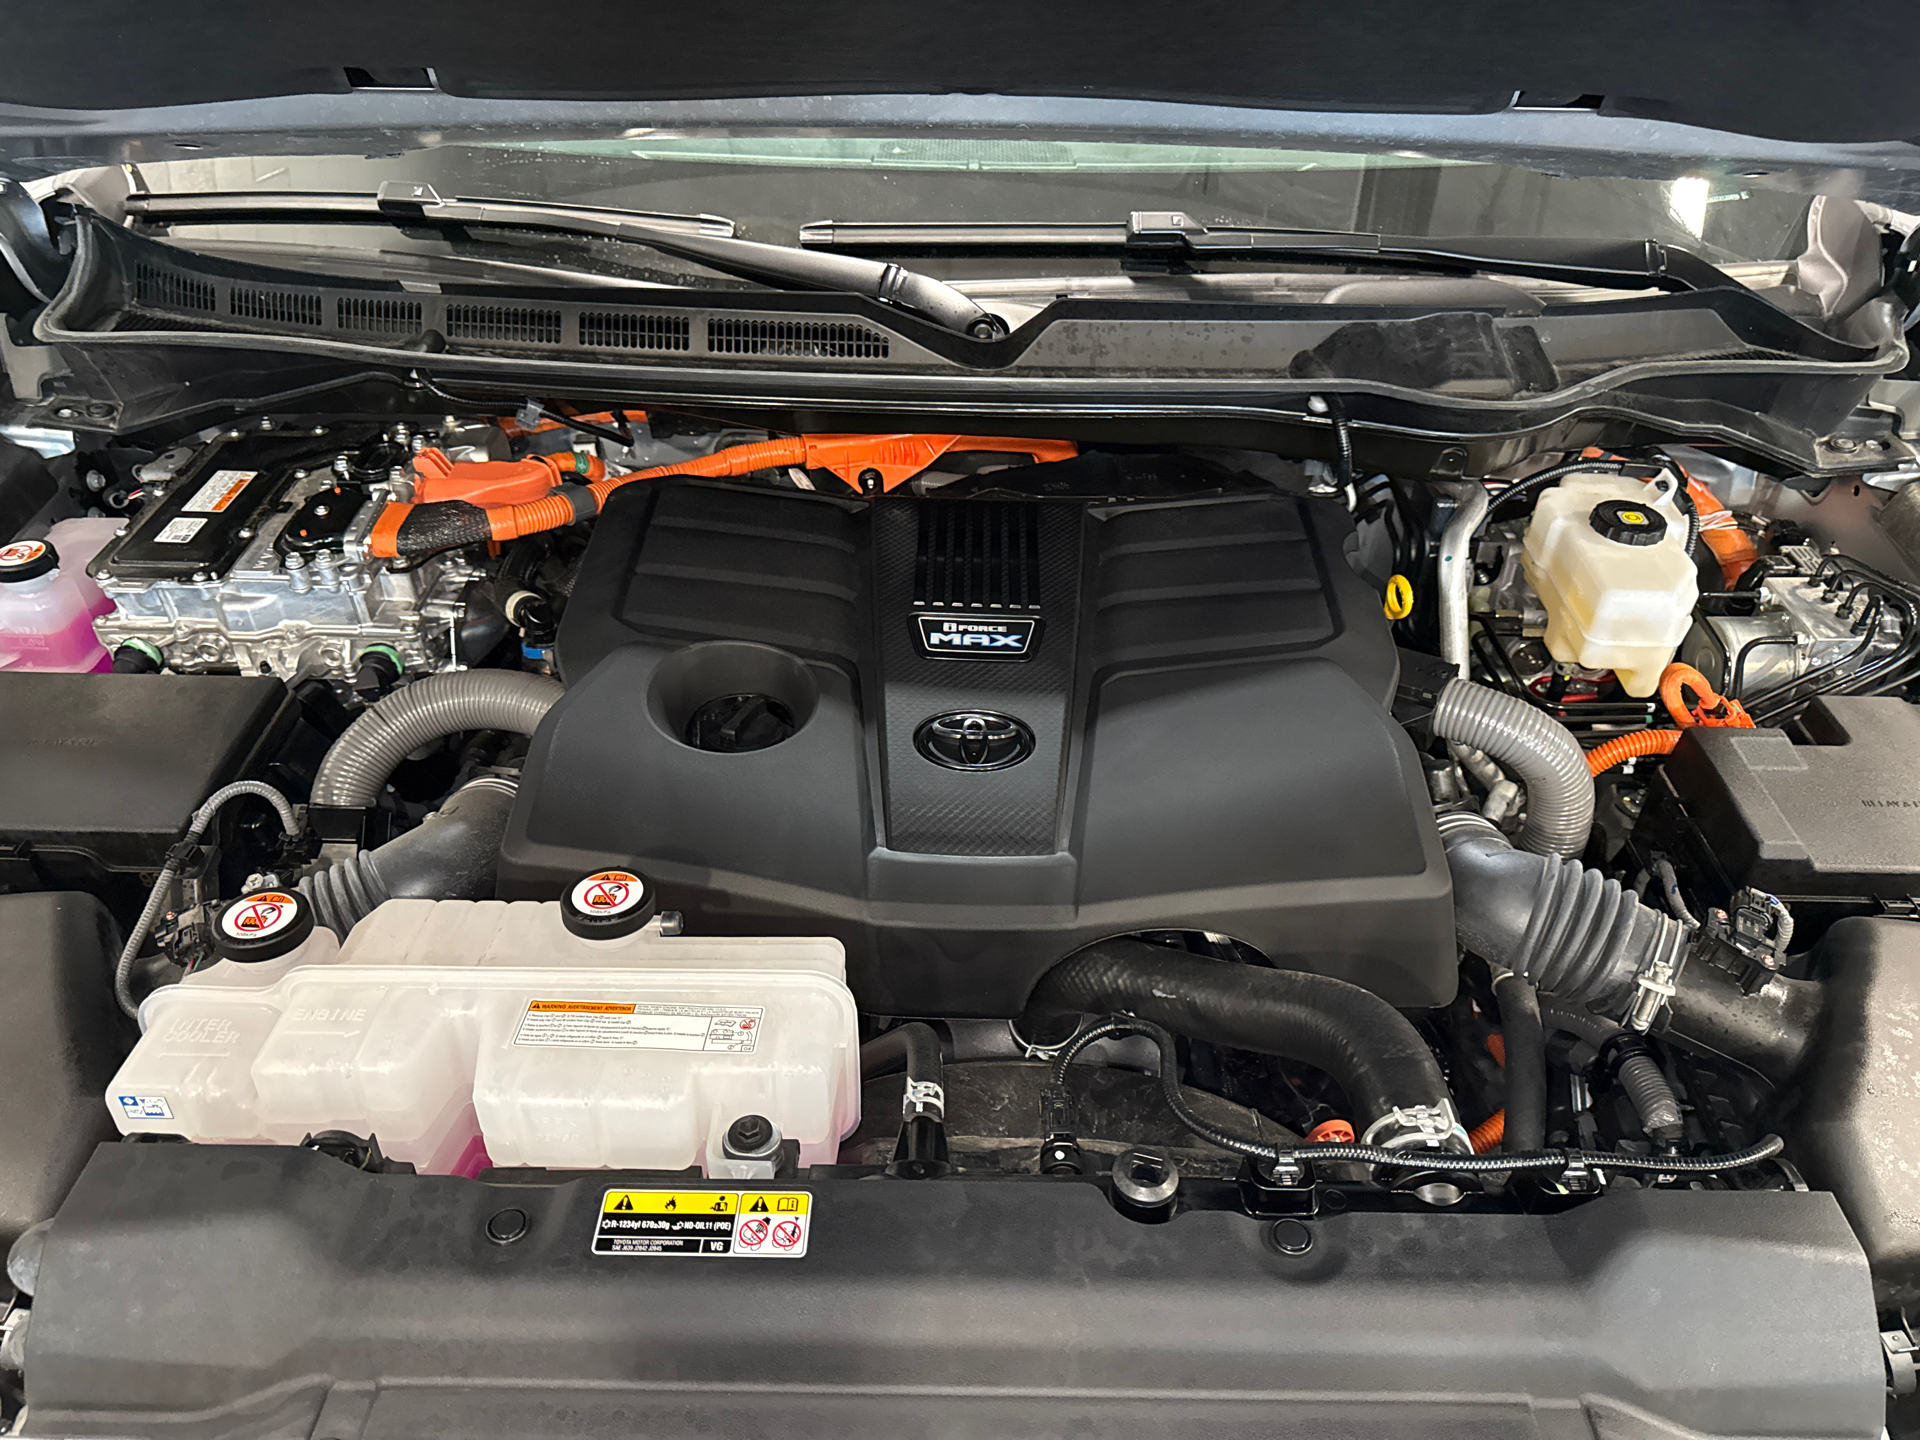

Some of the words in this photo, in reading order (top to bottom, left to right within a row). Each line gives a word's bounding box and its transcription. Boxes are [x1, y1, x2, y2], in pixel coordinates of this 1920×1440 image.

[930, 632, 1023, 647] MAX
[292, 1008, 368, 1022] ENGINE
[169, 1018, 233, 1031] INTER
[165, 1030, 241, 1044] COOLER
[611, 1220, 641, 1230] R-1234yf
[713, 1222, 731, 1231] (POE)
[710, 1241, 724, 1251] VG
